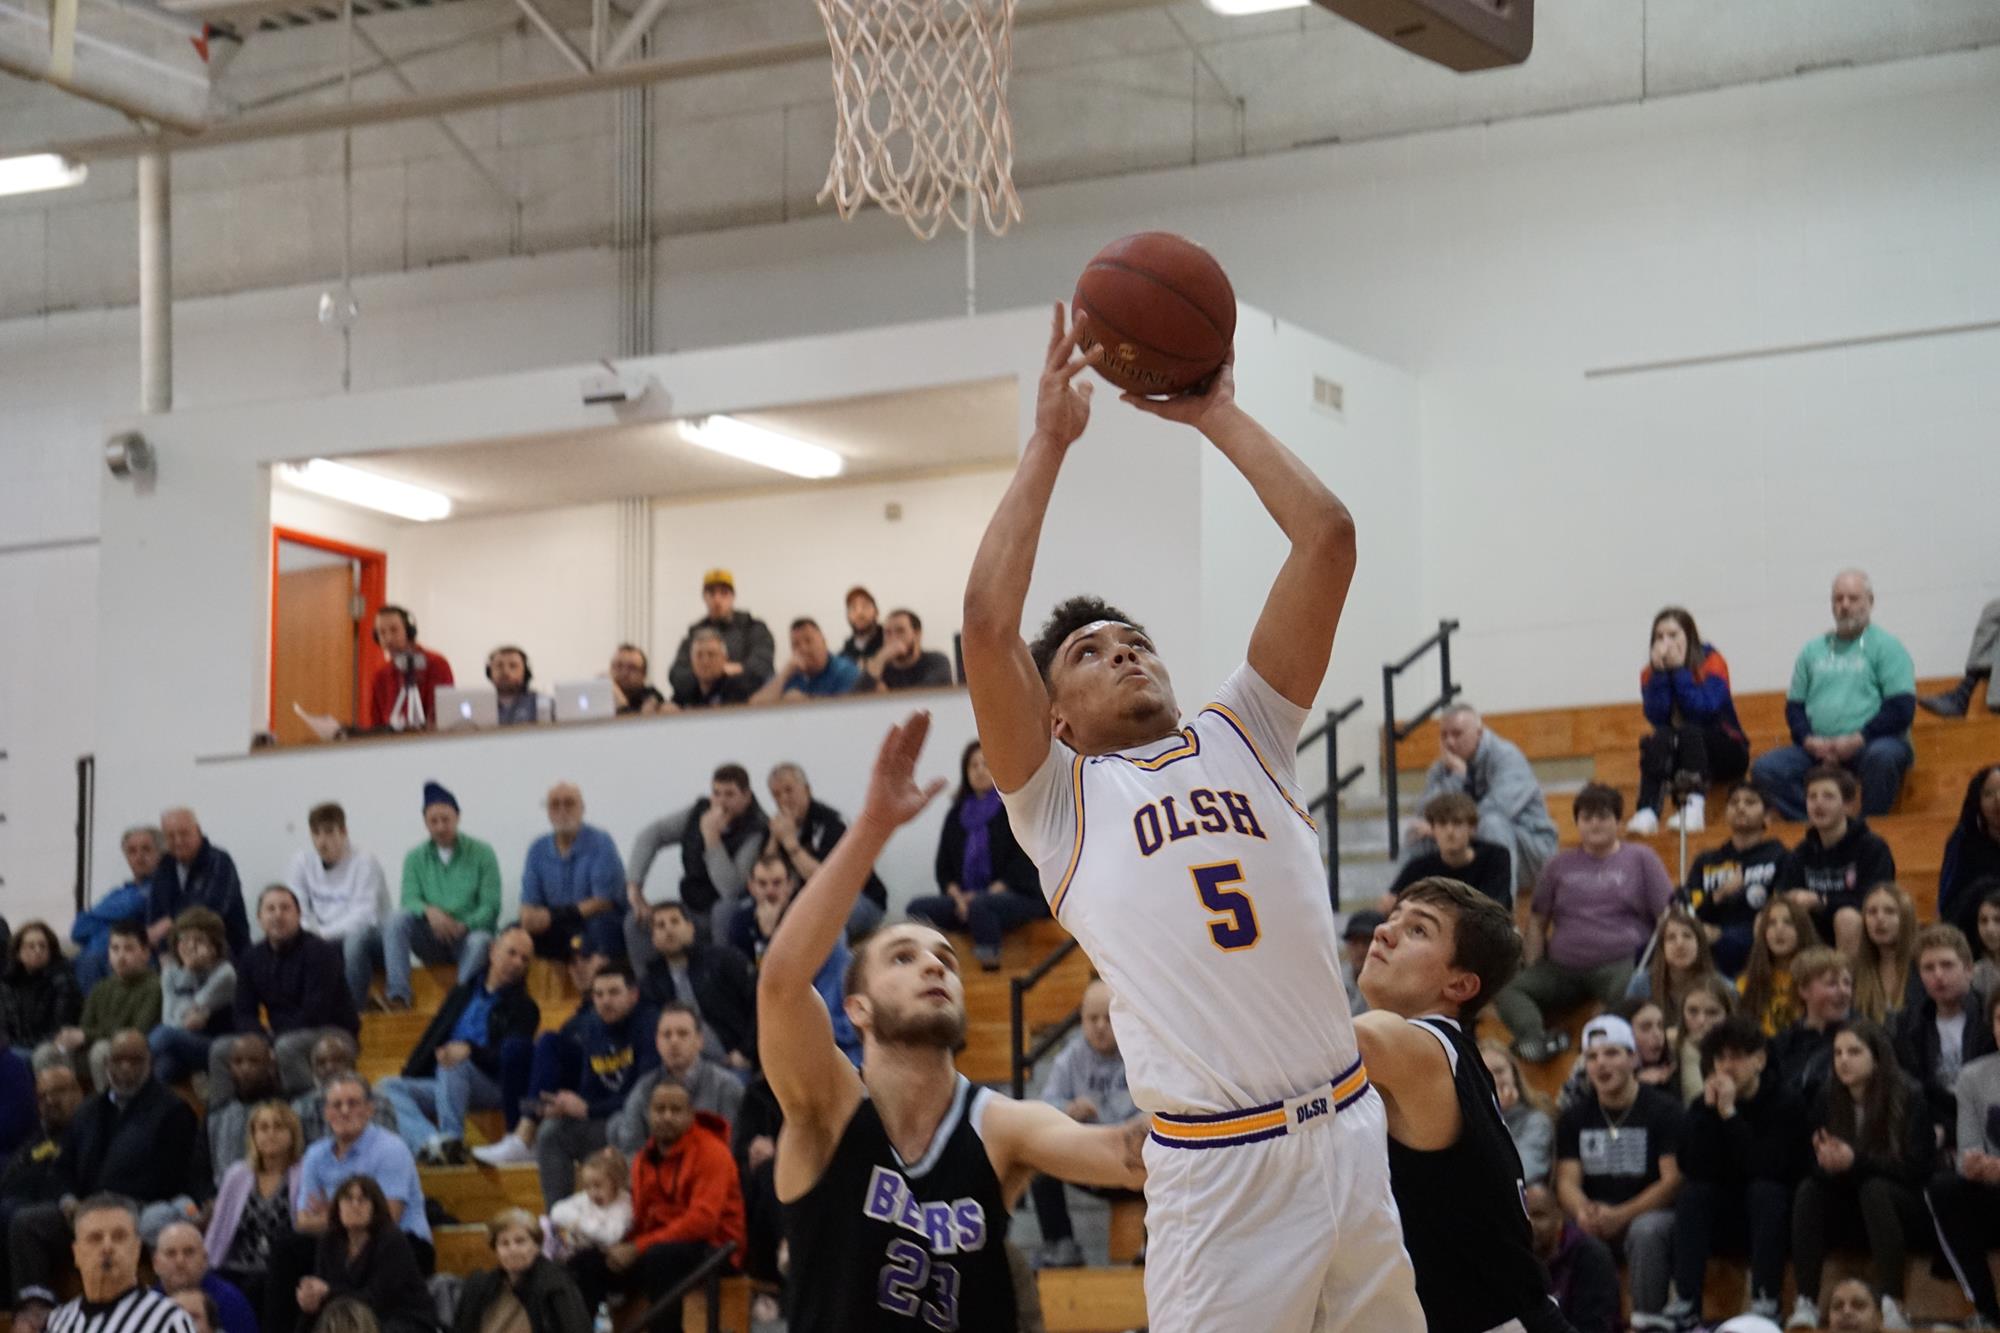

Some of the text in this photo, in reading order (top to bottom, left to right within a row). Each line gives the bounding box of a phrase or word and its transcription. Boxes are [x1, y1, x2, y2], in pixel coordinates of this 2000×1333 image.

[1133, 788, 1268, 857] OLSH
[1188, 858, 1262, 953] 5
[1296, 1097, 1329, 1124] OLSH
[876, 1238, 962, 1333] 23
